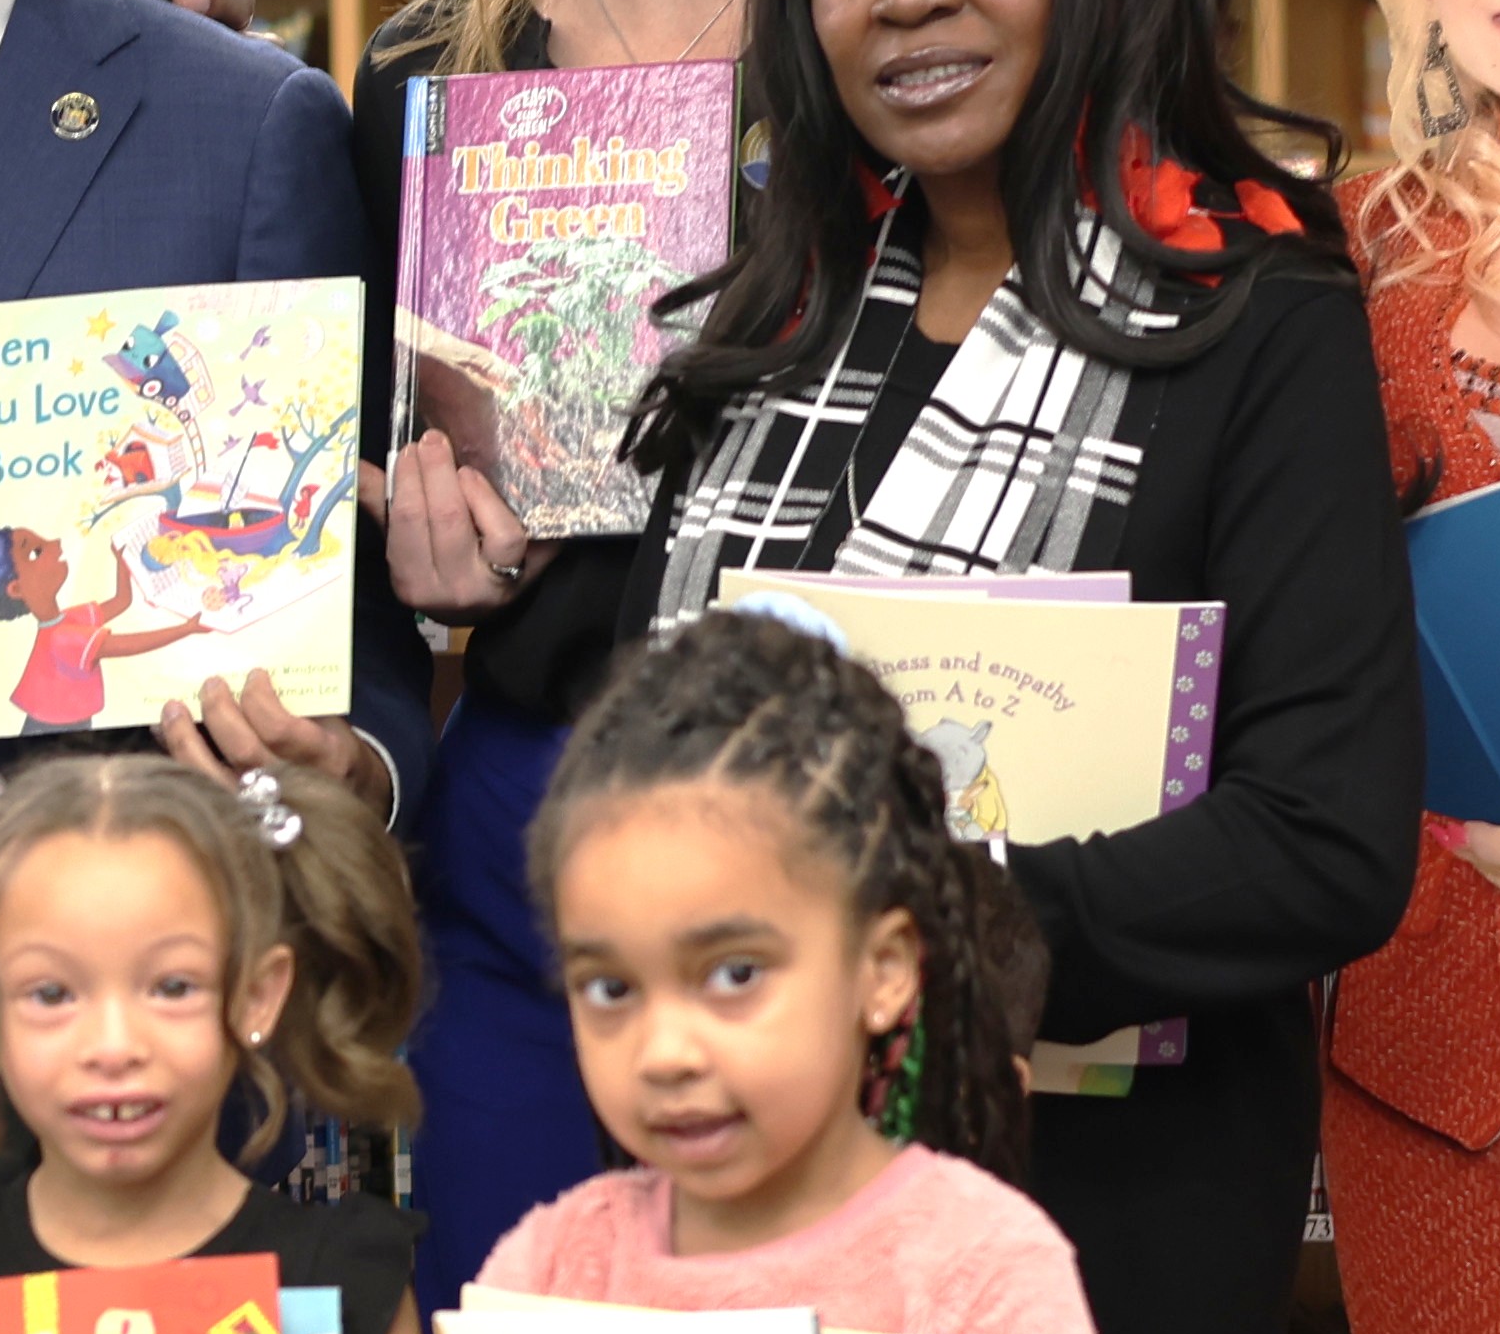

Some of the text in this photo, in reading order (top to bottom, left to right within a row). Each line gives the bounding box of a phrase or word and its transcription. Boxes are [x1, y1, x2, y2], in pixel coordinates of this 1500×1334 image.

[452, 136, 692, 197] Thinking
[490, 196, 646, 245] Green
[35, 383, 120, 425] Love
[902, 680, 1021, 718] om A to Z
[939, 651, 982, 673] and
[988, 662, 1076, 712] empathy
